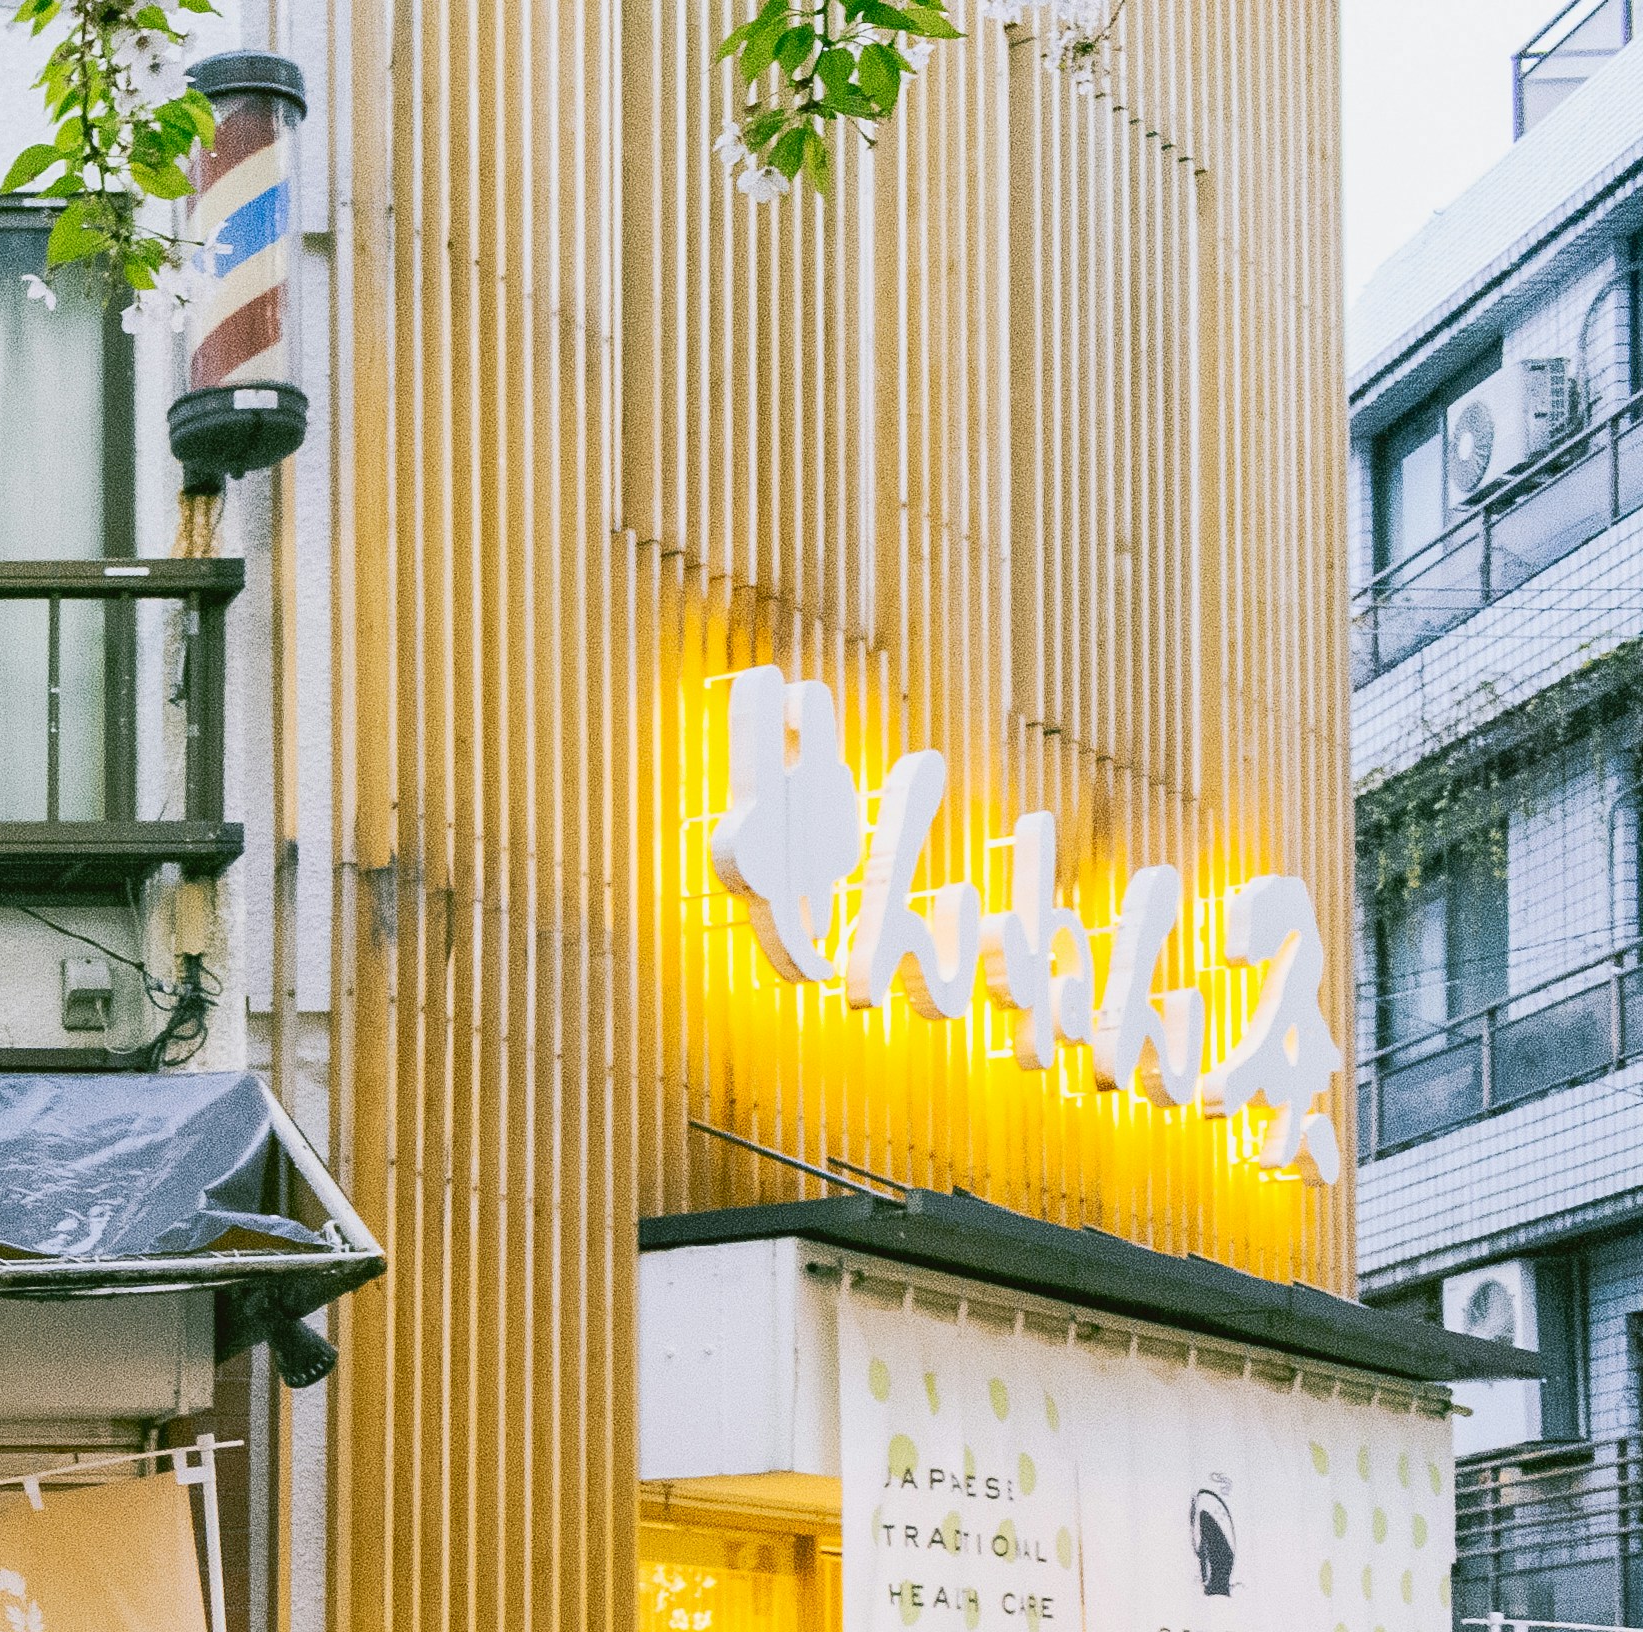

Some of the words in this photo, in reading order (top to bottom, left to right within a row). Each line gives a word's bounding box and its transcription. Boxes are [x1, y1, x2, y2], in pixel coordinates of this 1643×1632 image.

[711, 664, 1342, 1185] せんねん灸
[884, 1467, 1014, 1501] JAPAESE
[883, 1524, 1047, 1563] TRADTIONAL
